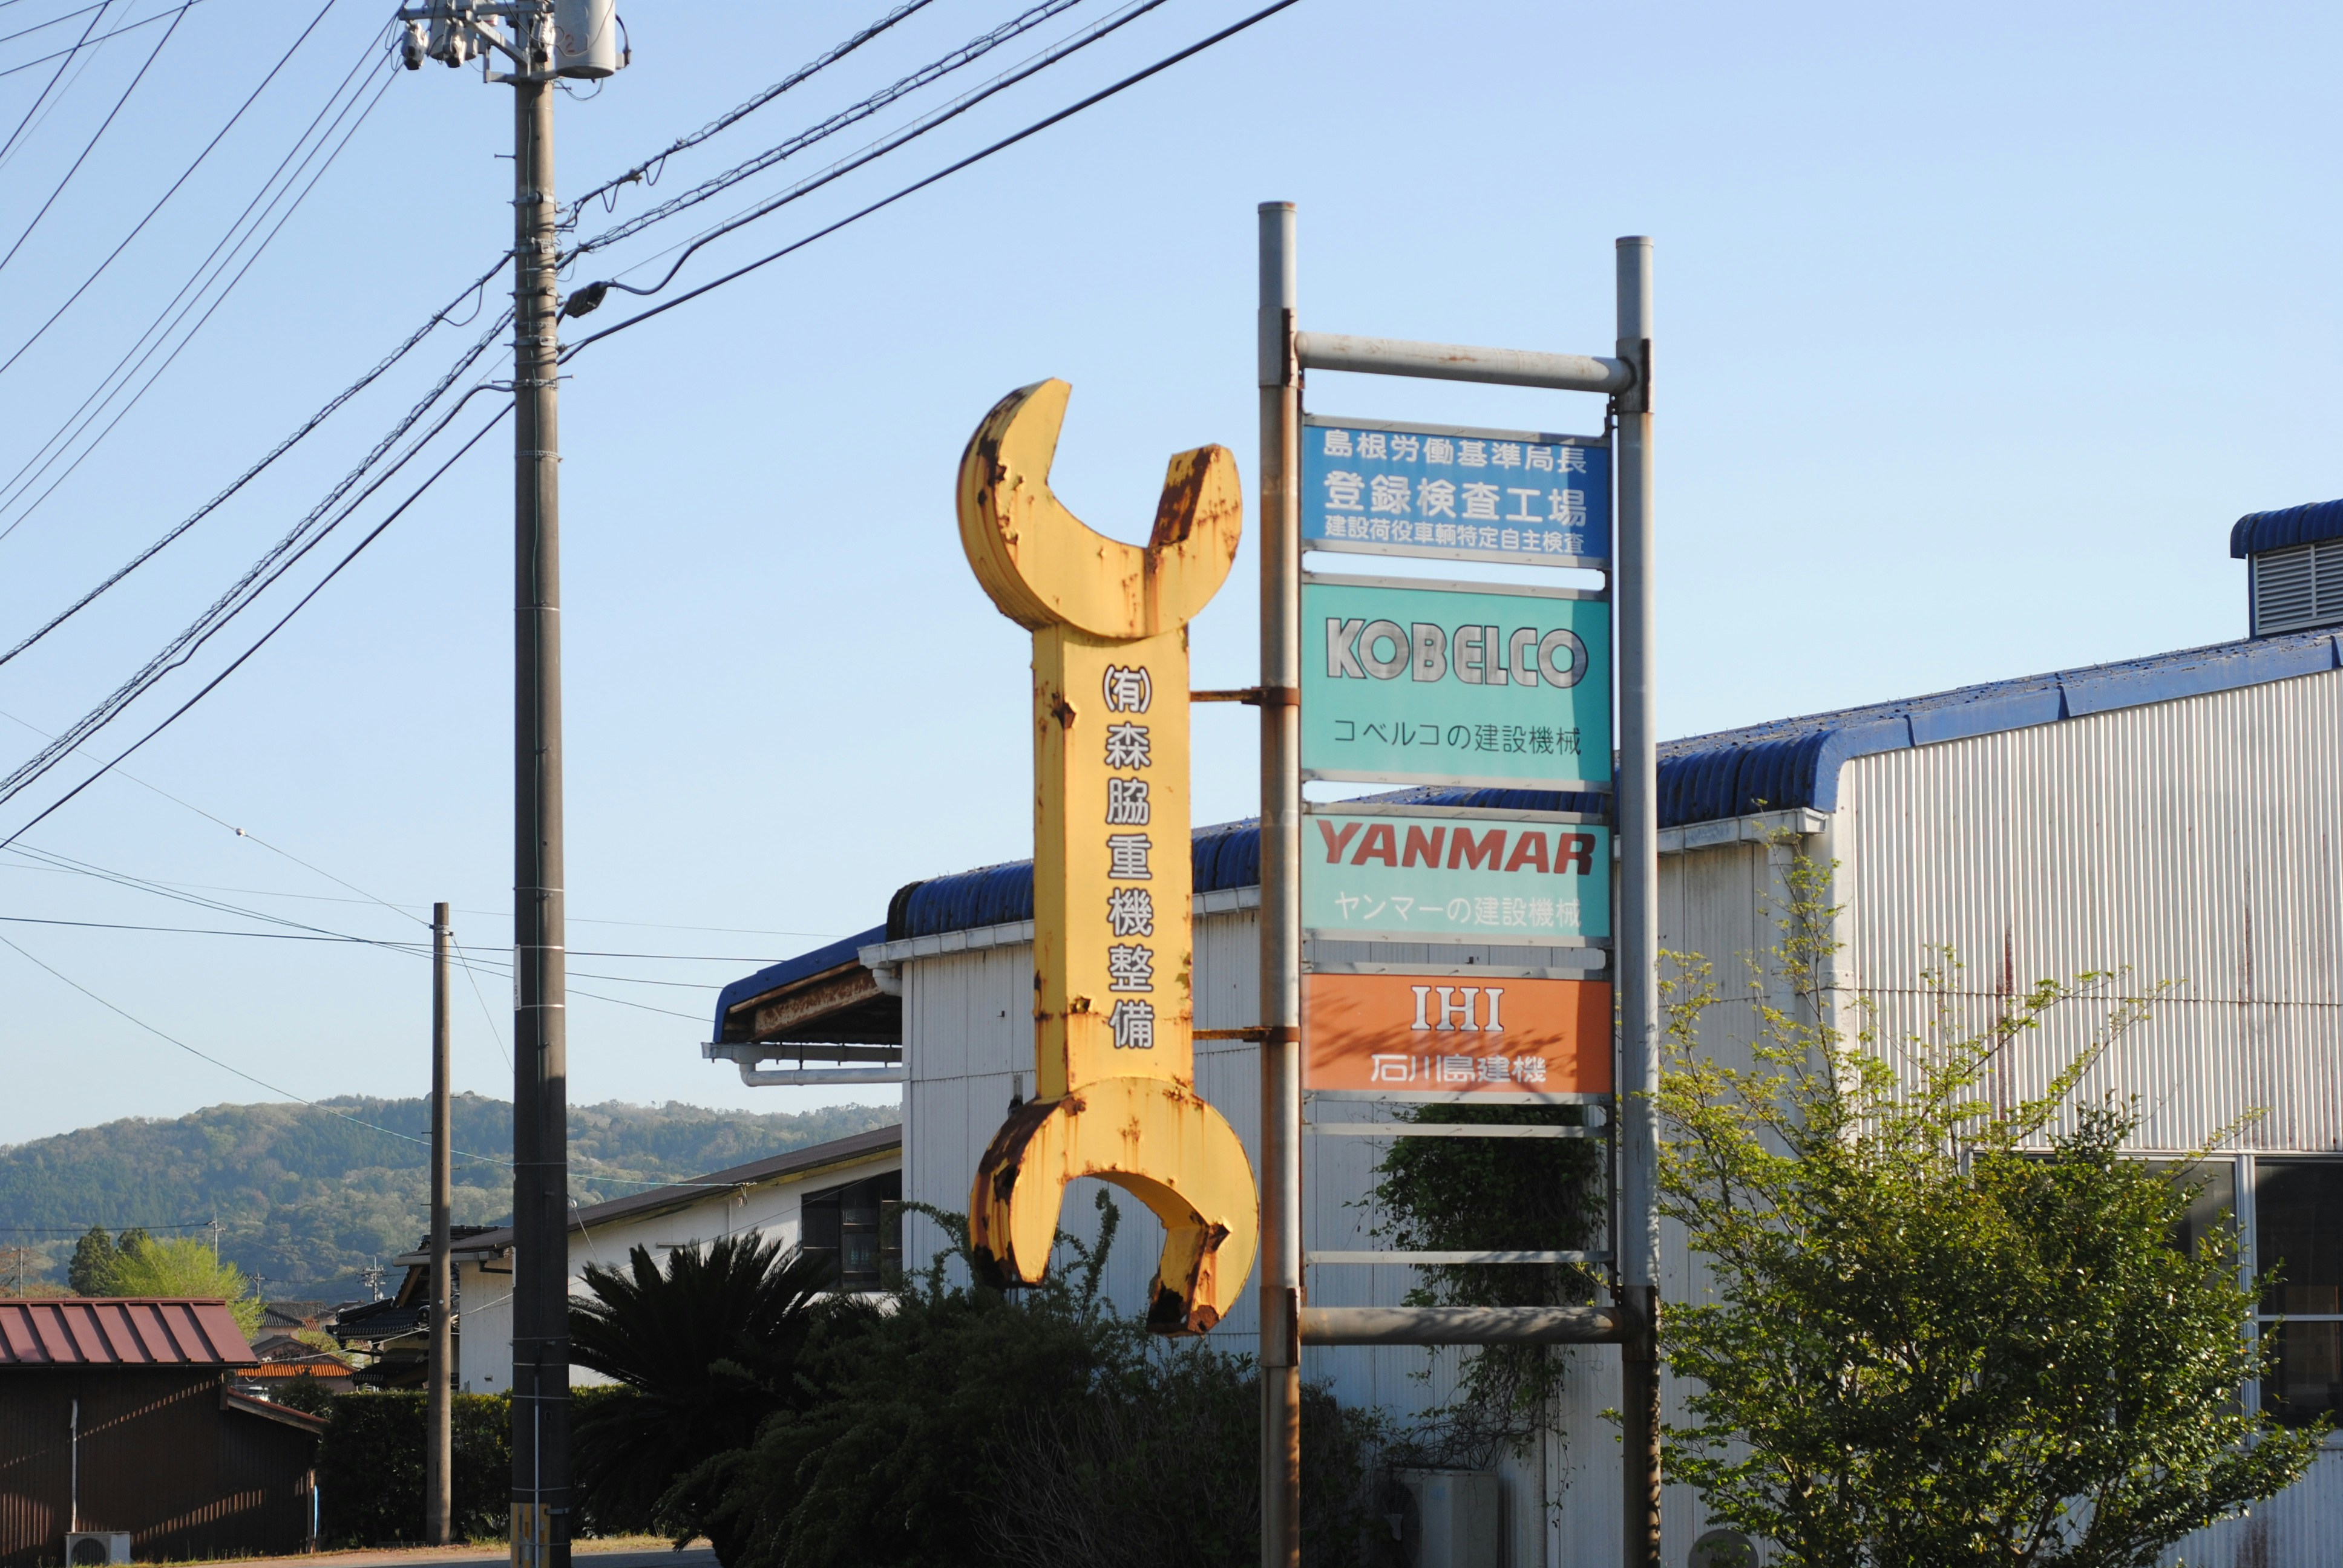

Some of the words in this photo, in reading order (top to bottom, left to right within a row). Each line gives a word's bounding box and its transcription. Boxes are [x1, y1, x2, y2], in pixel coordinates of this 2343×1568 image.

[1323, 429, 1587, 474] 島根労働基準局長
[1323, 470, 1587, 527] 登録検査工場
[1325, 617, 1589, 689] KOBELCO
[1334, 719, 1582, 756] コベルコの建設機械
[1316, 818, 1596, 876] YANMAR
[1334, 890, 1582, 929] ヤンマーの建設機械
[1410, 985, 1505, 1032] IHI
[1370, 1053, 1547, 1083] 石川島建機
